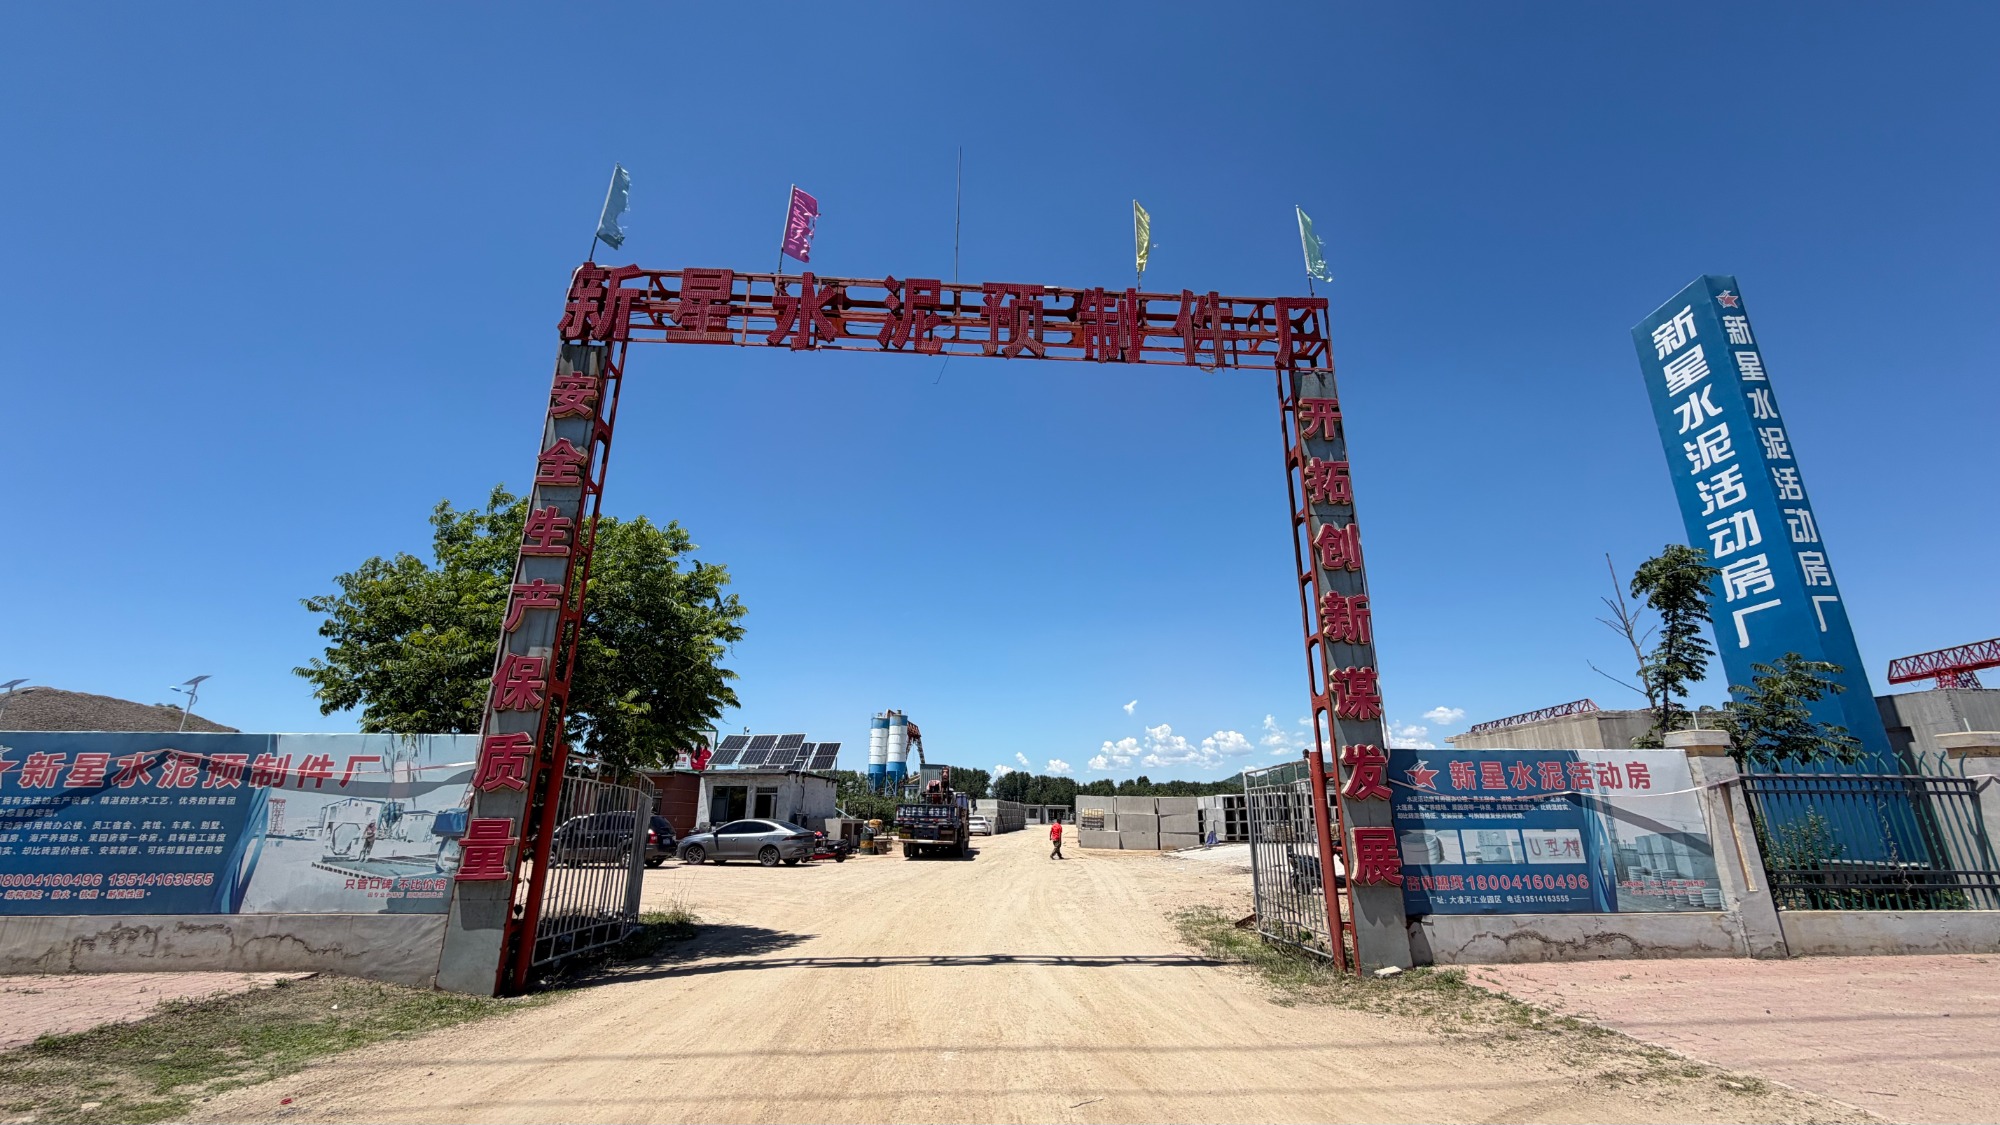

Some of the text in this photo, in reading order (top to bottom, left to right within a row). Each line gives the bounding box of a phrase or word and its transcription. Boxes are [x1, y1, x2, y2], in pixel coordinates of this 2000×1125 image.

[557, 260, 1328, 369] 新星水泥预制件厂
[1652, 304, 1781, 649] 新星水泥活动房厂
[1723, 314, 1838, 633] 新星水泥活动房厂
[454, 370, 599, 883] 安全生产保质量
[1300, 396, 1404, 887] 开拓创新谋发展
[18, 751, 382, 789] 新星水泥预制件厂
[1449, 760, 1651, 790] 新星水泥活动房
[0, 796, 237, 805] 拥有先进的生产设备，精湛的技术工艺，优秀的管理团
[0, 820, 225, 830] 动房可用做办公楼、员工宿舍、宾馆、车库、别墅、
[0, 846, 223, 855] 实、却比砖混价格低、安装简便、可拆卸重复使用等
[108, 873, 215, 886] 13514163555
[344, 878, 448, 891] 只管口碑 不比价格
